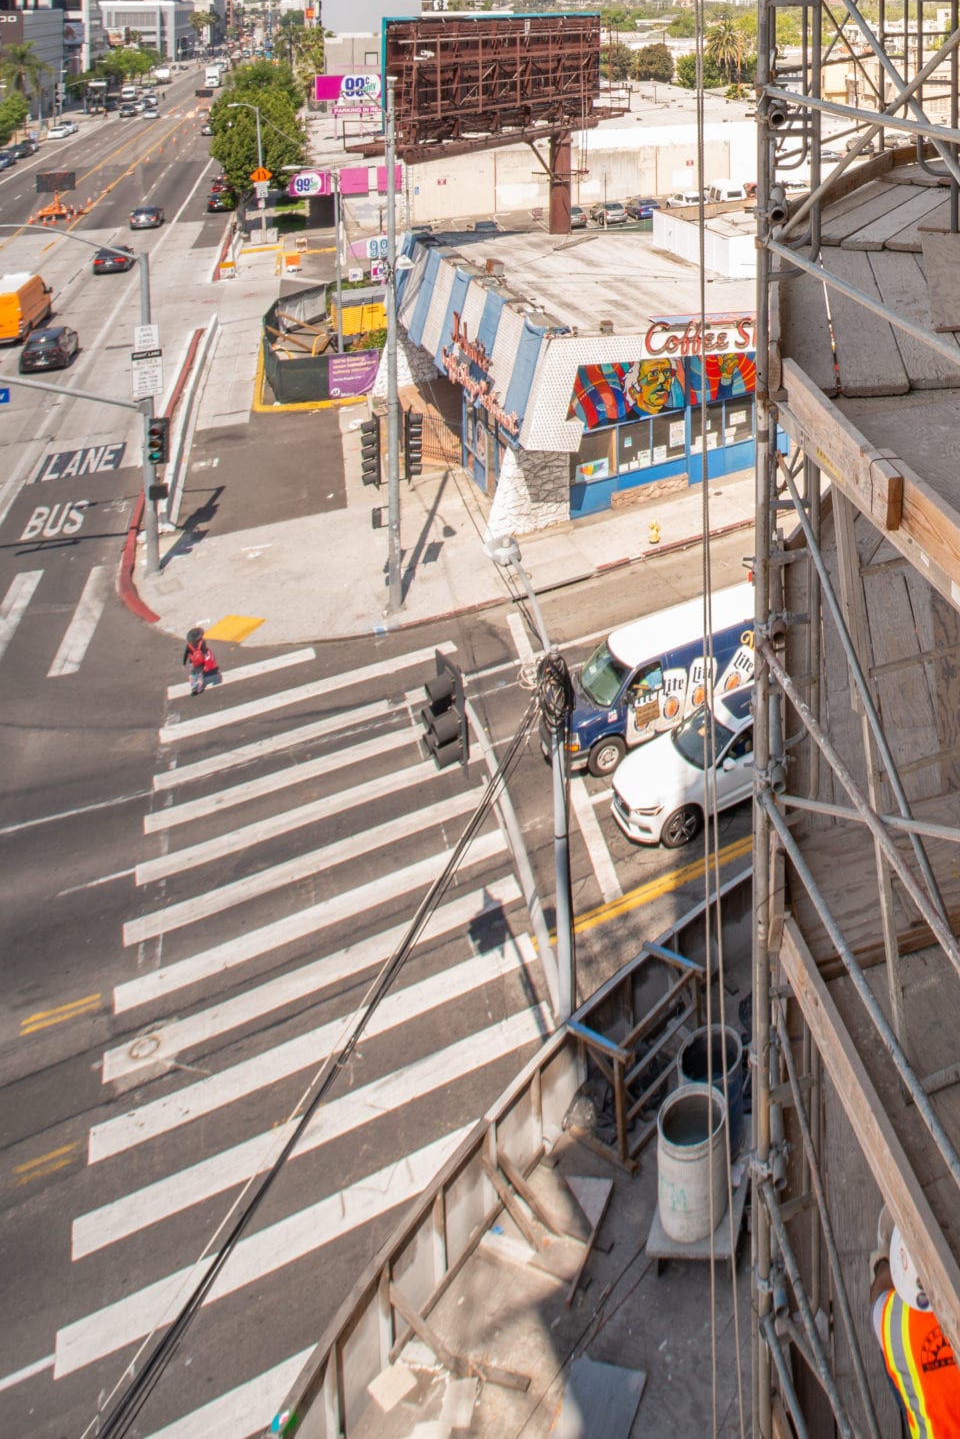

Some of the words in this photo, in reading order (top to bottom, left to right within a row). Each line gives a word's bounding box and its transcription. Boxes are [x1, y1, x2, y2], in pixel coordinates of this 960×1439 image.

[645, 321, 729, 356] Coffee
[41, 443, 124, 482] LANE
[19, 500, 90, 541] BUS
[733, 651, 754, 673] Lite
